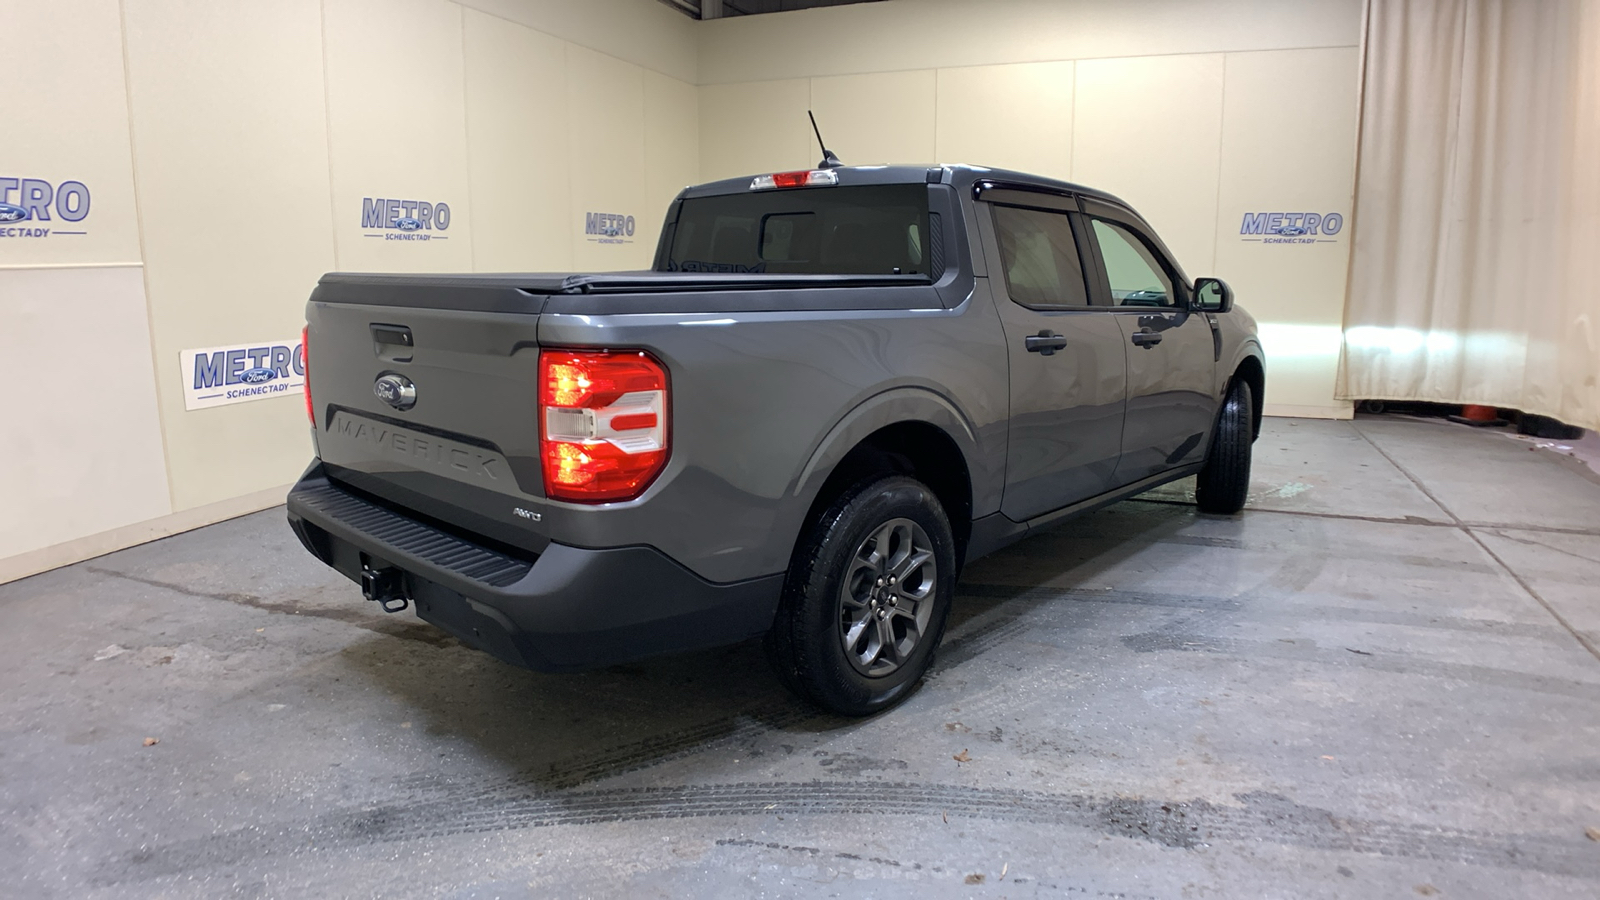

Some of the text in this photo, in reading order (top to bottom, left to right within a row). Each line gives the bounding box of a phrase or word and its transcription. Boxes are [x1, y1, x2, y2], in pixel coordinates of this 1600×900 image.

[361, 197, 450, 231] METRO
[585, 211, 635, 237] METRO
[1240, 212, 1343, 236] METRO
[384, 233, 431, 241] SCHENECTADY
[246, 371, 269, 382] Ford
[226, 383, 289, 399] SCHENECTADY
[377, 382, 394, 399] Ford
[336, 417, 498, 480] MAVERICK
